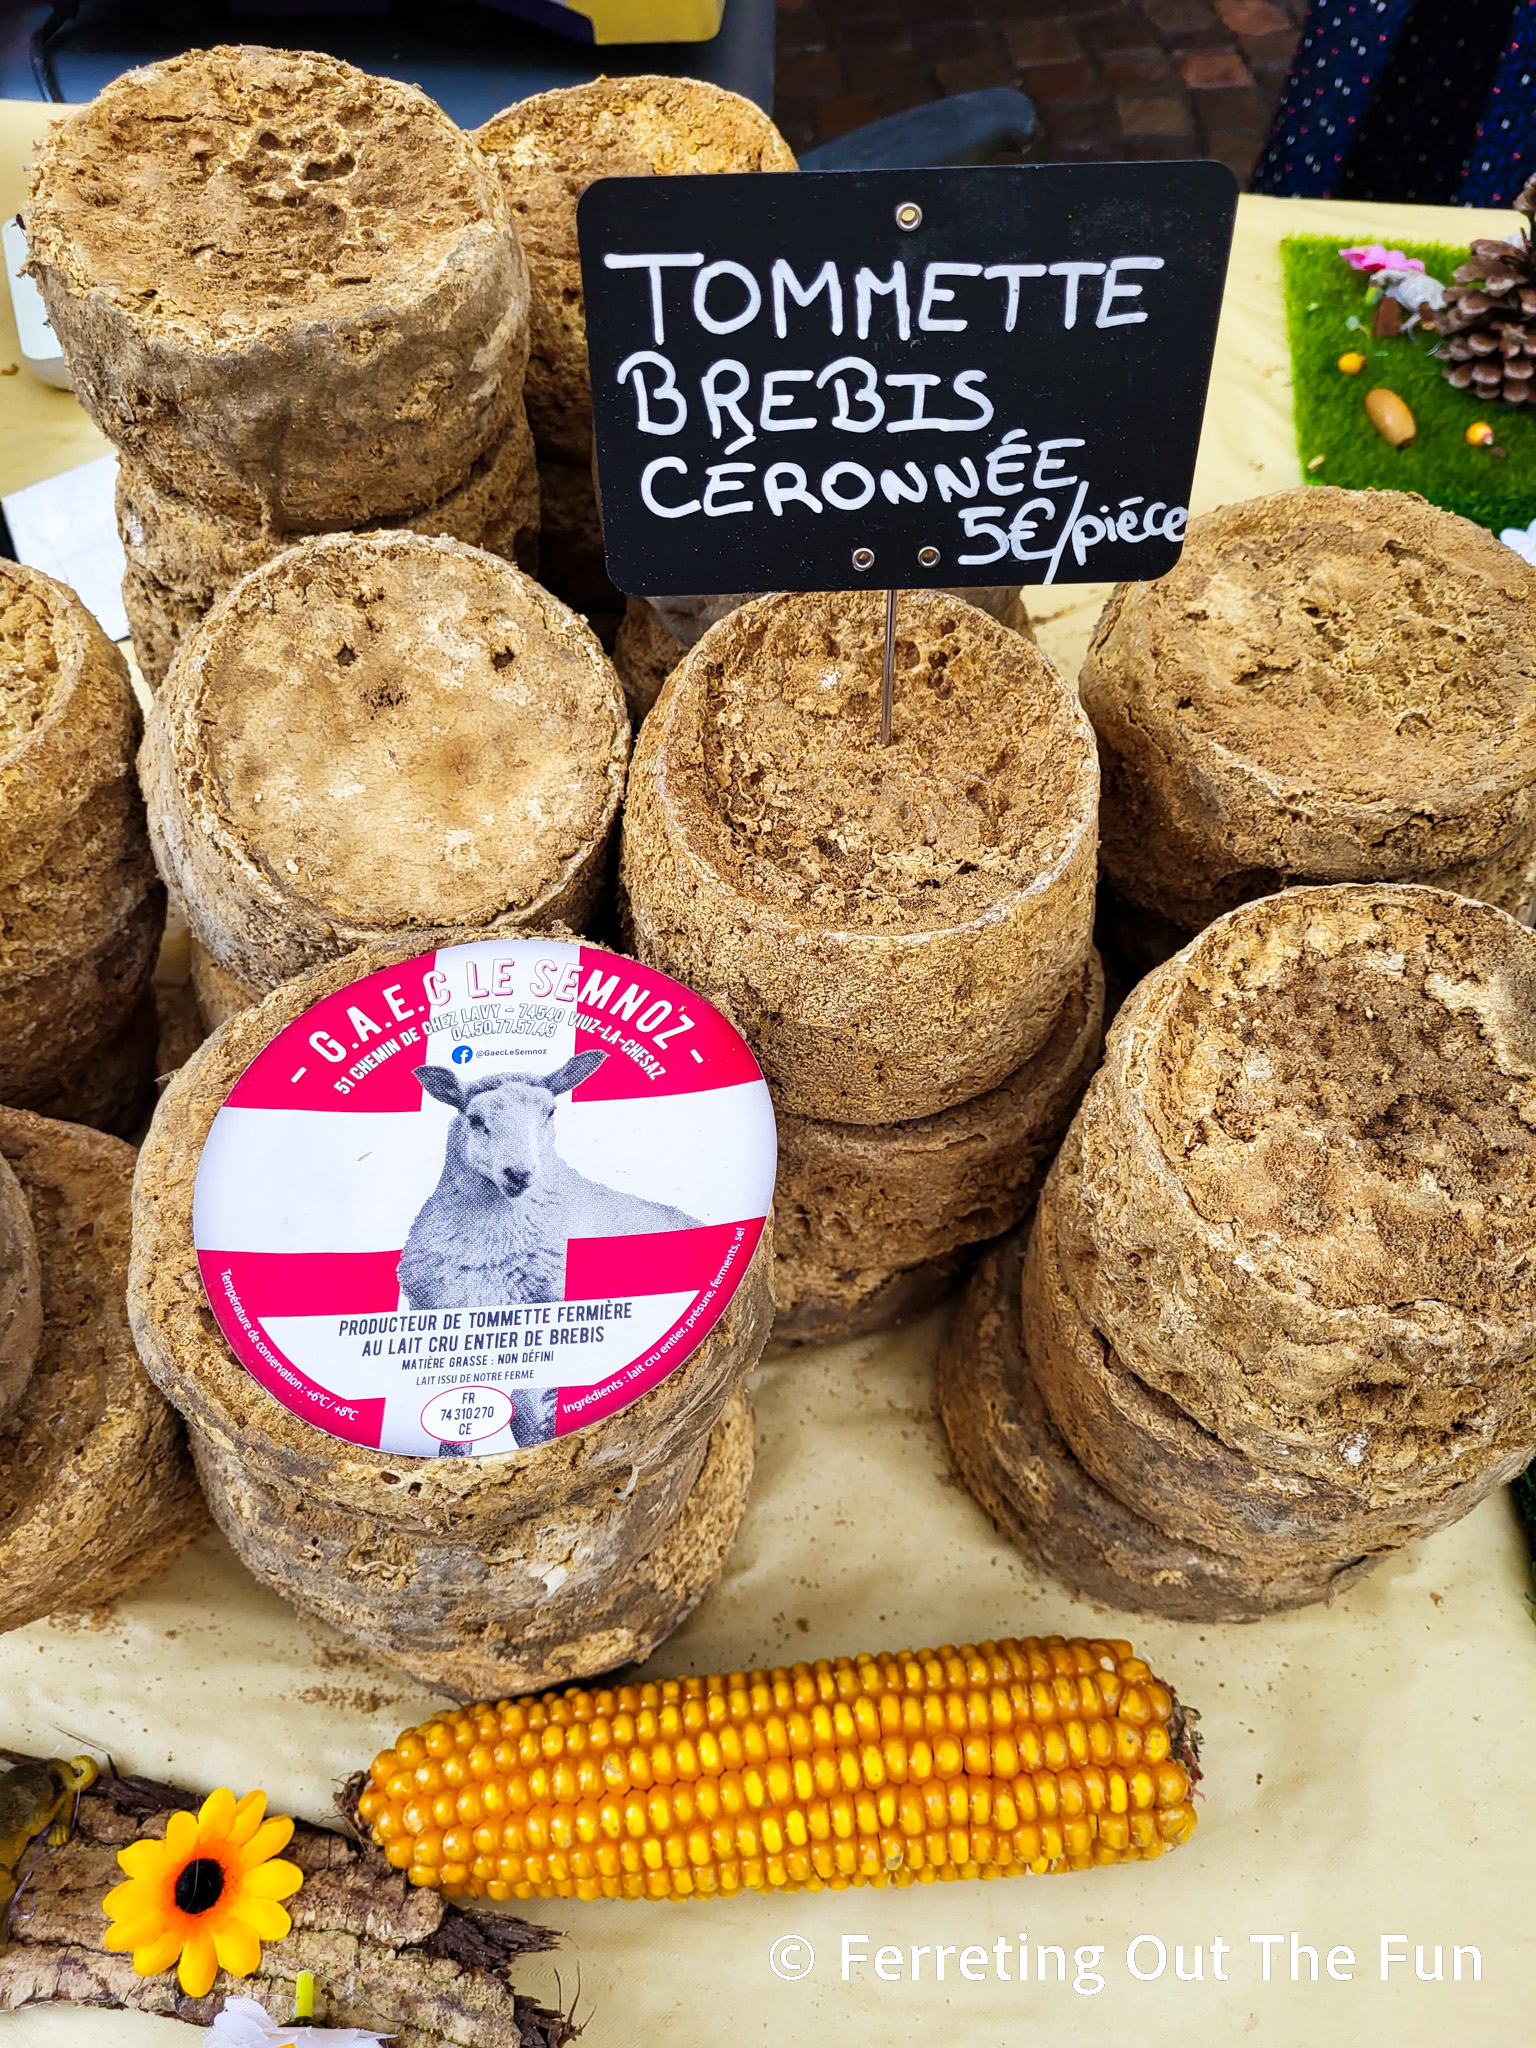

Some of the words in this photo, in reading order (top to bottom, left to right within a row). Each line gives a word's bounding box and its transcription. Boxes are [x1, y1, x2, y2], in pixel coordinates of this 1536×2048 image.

[604, 253, 1164, 344] TOMMETTE
[618, 351, 994, 439] BREBIS
[640, 430, 1085, 518] CÉRONNÉE
[309, 970, 452, 1063] G.A.E.C
[466, 958, 516, 1000] LE
[529, 958, 695, 1050] SEMNOZ
[333, 1076, 356, 1095] 51
[349, 1038, 401, 1080] CHEMIN
[399, 1026, 421, 1047] DE
[421, 1011, 459, 1036] CHEZ
[461, 1003, 501, 1023] LAVY
[519, 1003, 566, 1023] 74540
[568, 1012, 667, 1081] VIUZ-LA-CHESAZ
[451, 1019, 558, 1042] 04.50.77.57.43
[476, 1048, 547, 1059] @GaecLeSemnoz
[221, 1268, 253, 1331] Température
[248, 1329, 260, 1343] de
[339, 1313, 437, 1337] PRODUCTEUR
[443, 1313, 461, 1330] DE
[469, 1308, 551, 1329] TOMMETTE
[557, 1299, 633, 1323] FERMIÈRE
[626, 1366, 645, 1380] lait
[644, 1353, 661, 1367] cru
[660, 1326, 688, 1354] entier,
[685, 1289, 717, 1328] présure,
[734, 1227, 746, 1242] sel
[361, 1340, 382, 1357] AU
[388, 1337, 422, 1355] LAIT
[429, 1335, 458, 1352] CRU
[464, 1331, 518, 1350] ENTIER
[524, 1330, 543, 1347] DE
[549, 1325, 605, 1345] BREBIS
[402, 1355, 445, 1371] MATIÈRE
[449, 1355, 488, 1368] GRASSE
[497, 1352, 519, 1365] NON
[522, 1349, 554, 1363] DÉFINI
[416, 1375, 436, 1386] LAIT
[437, 1374, 457, 1384] ISSU
[459, 1373, 471, 1383] DE
[473, 1371, 502, 1382] NOTRE
[504, 1369, 535, 1380] FERME
[462, 1392, 475, 1404] FR
[458, 1423, 473, 1435] CE
